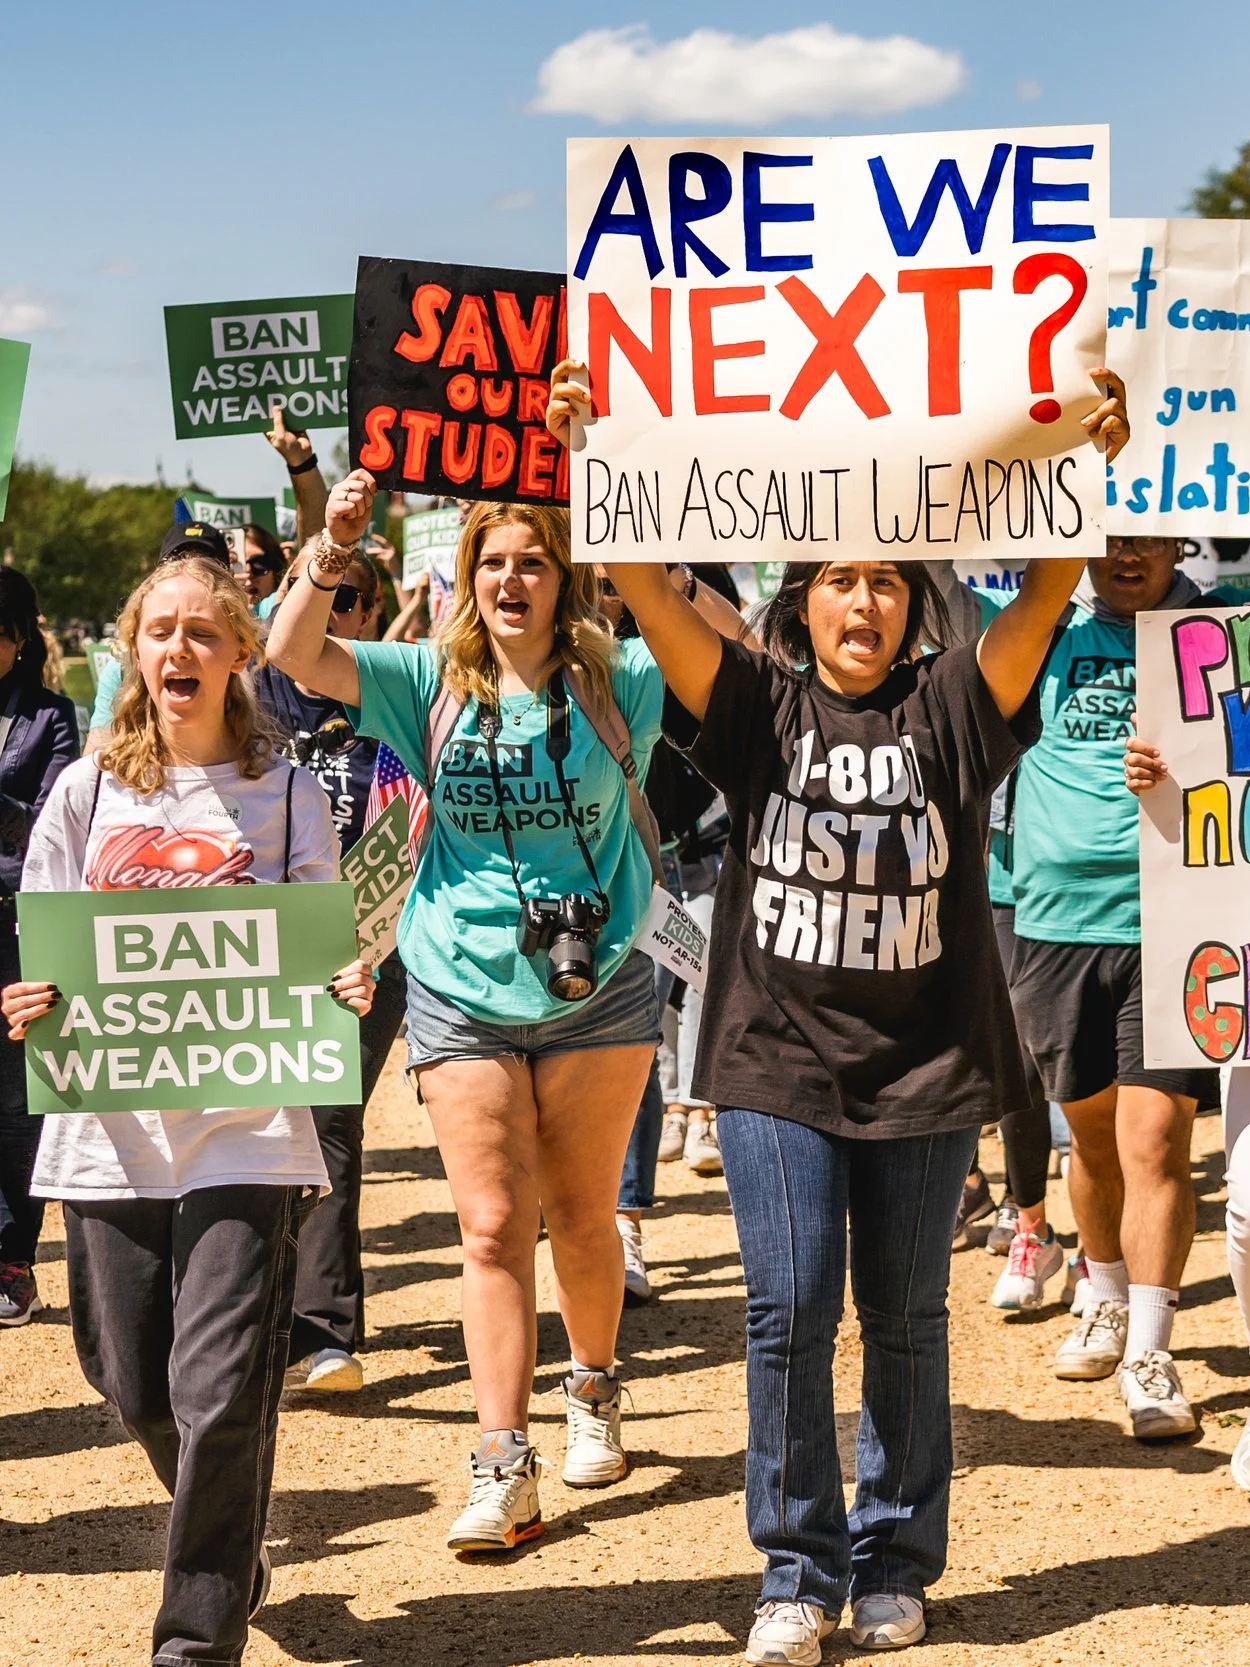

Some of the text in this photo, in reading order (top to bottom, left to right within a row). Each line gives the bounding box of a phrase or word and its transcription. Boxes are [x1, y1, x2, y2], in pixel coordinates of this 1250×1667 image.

[573, 142, 1097, 281] ARE WE
[222, 316, 309, 352] BAN
[588, 252, 1089, 425] NEXT?
[192, 356, 347, 393] ASSAULT
[446, 373, 551, 422] OUR
[1156, 386, 1237, 427] gun
[200, 506, 245, 526] BAN
[586, 455, 1084, 546] BAN ASSAULT WEAPONS
[1074, 660, 1136, 688] BAN
[1064, 693, 1136, 717] ASSA
[1063, 718, 1131, 742] WEA
[446, 743, 526, 773] BAN
[442, 777, 581, 807] ASSAULT
[445, 802, 600, 834] WEAPONS
[750, 792, 891, 887] JUST
[652, 930, 674, 949] NOT
[667, 900, 707, 945] PROTECT
[667, 919, 701, 953] KIDS
[113, 918, 262, 973] BAN
[59, 984, 324, 1038] ASSAULT
[42, 1039, 345, 1092] WEAPONS
